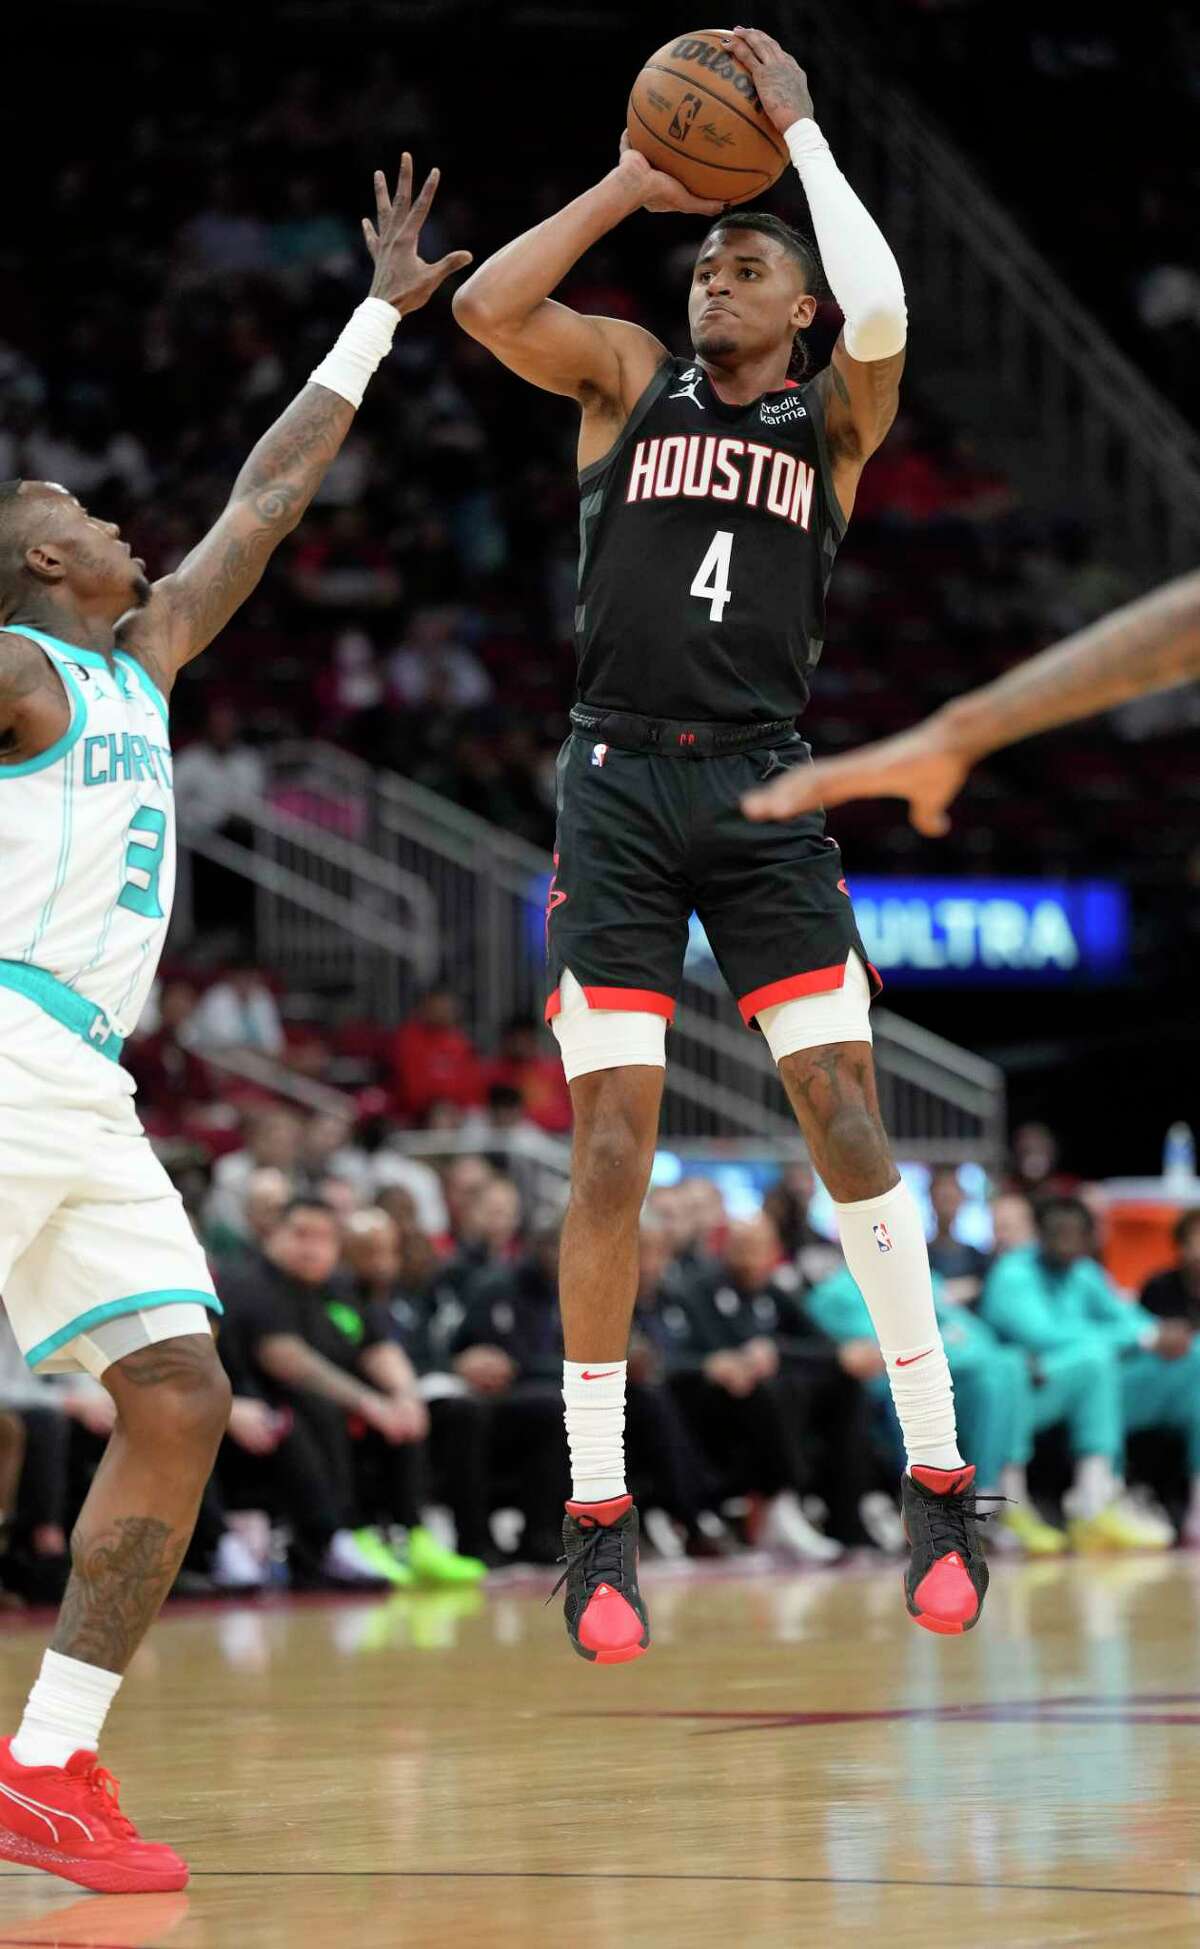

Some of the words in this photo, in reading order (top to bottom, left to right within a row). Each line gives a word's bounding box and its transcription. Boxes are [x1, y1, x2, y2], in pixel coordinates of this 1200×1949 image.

[760, 407, 807, 425] karma
[625, 436, 816, 532] HOUSTON
[690, 530, 734, 622] 4
[117, 805, 166, 918] 3
[856, 898, 1080, 971] ULTRA
